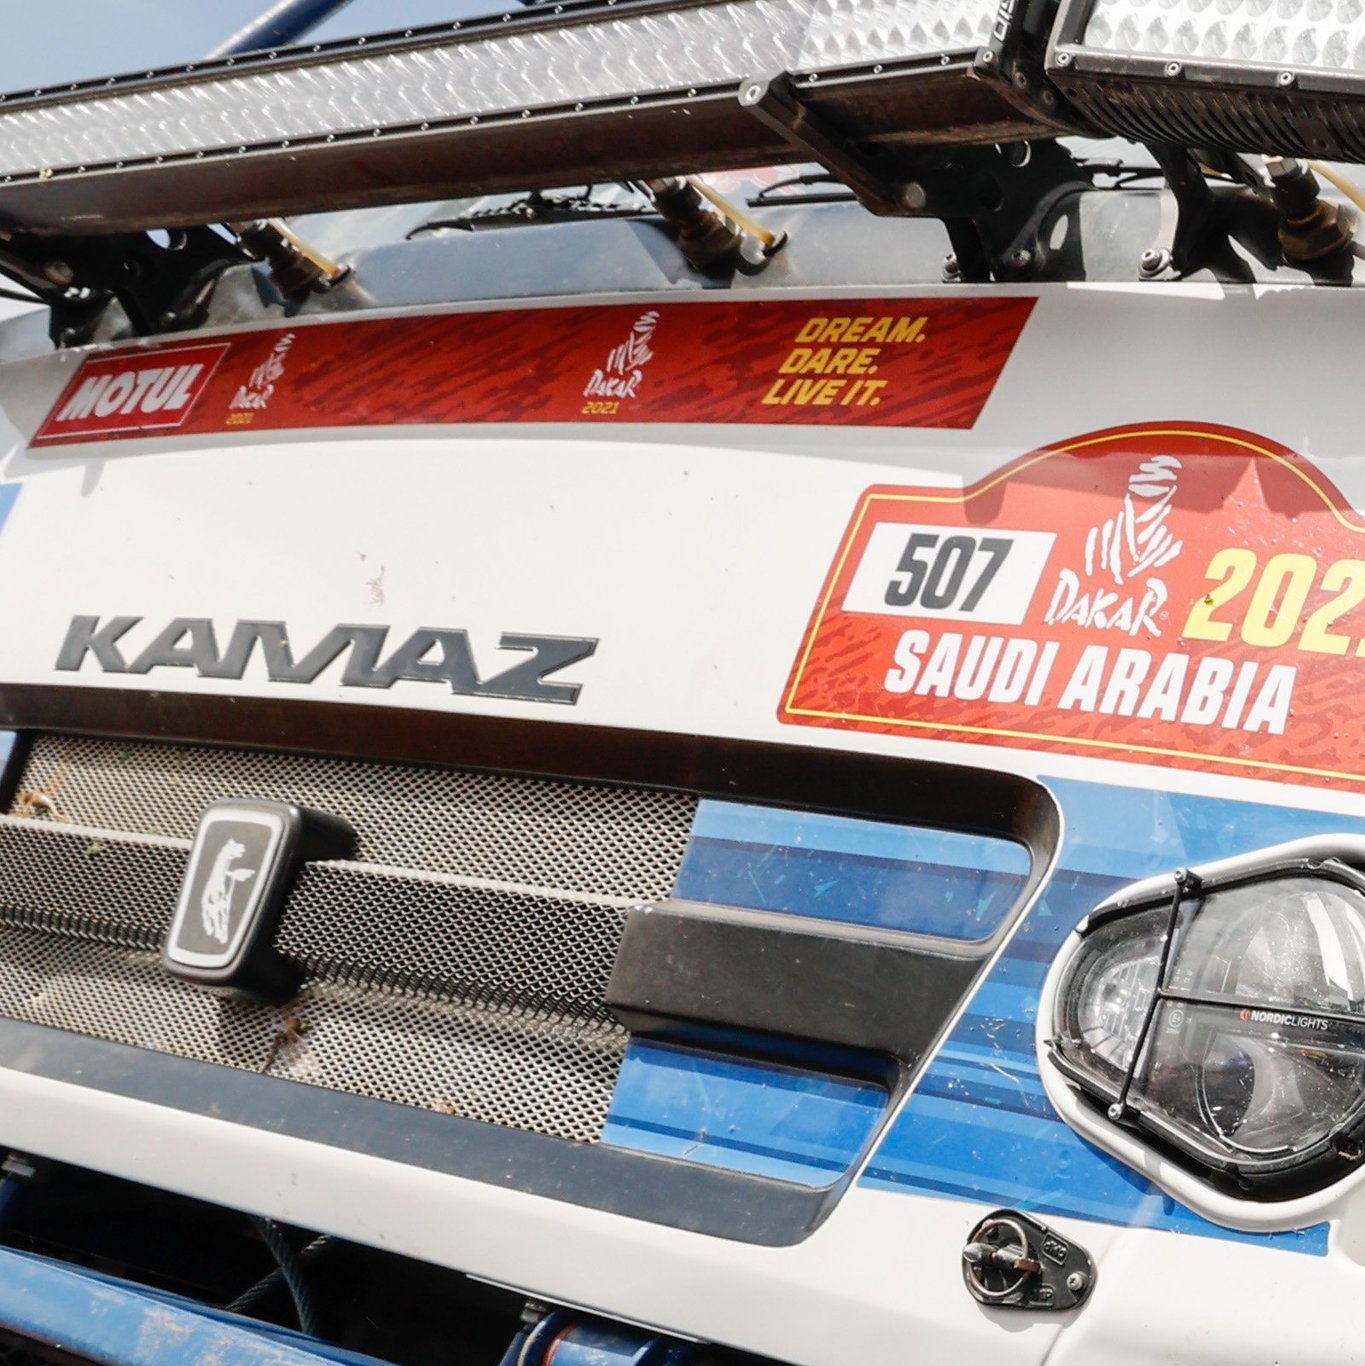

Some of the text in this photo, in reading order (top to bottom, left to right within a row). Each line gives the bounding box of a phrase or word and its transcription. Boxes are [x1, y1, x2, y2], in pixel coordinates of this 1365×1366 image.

[794, 316, 927, 344] DREAM.
[777, 347, 882, 375] DARE.
[55, 363, 205, 422] MOTUL
[582, 368, 644, 399] DAKAR
[760, 378, 888, 407] LIVE IT.
[581, 400, 621, 415] 2021
[882, 532, 1013, 613] 507
[1044, 568, 1170, 638] DAKAR
[54, 614, 600, 706] KAMAZ
[884, 629, 1298, 736] SAUDI ARABIA
[1251, 1009, 1329, 1031] NORDICLIGHTS
